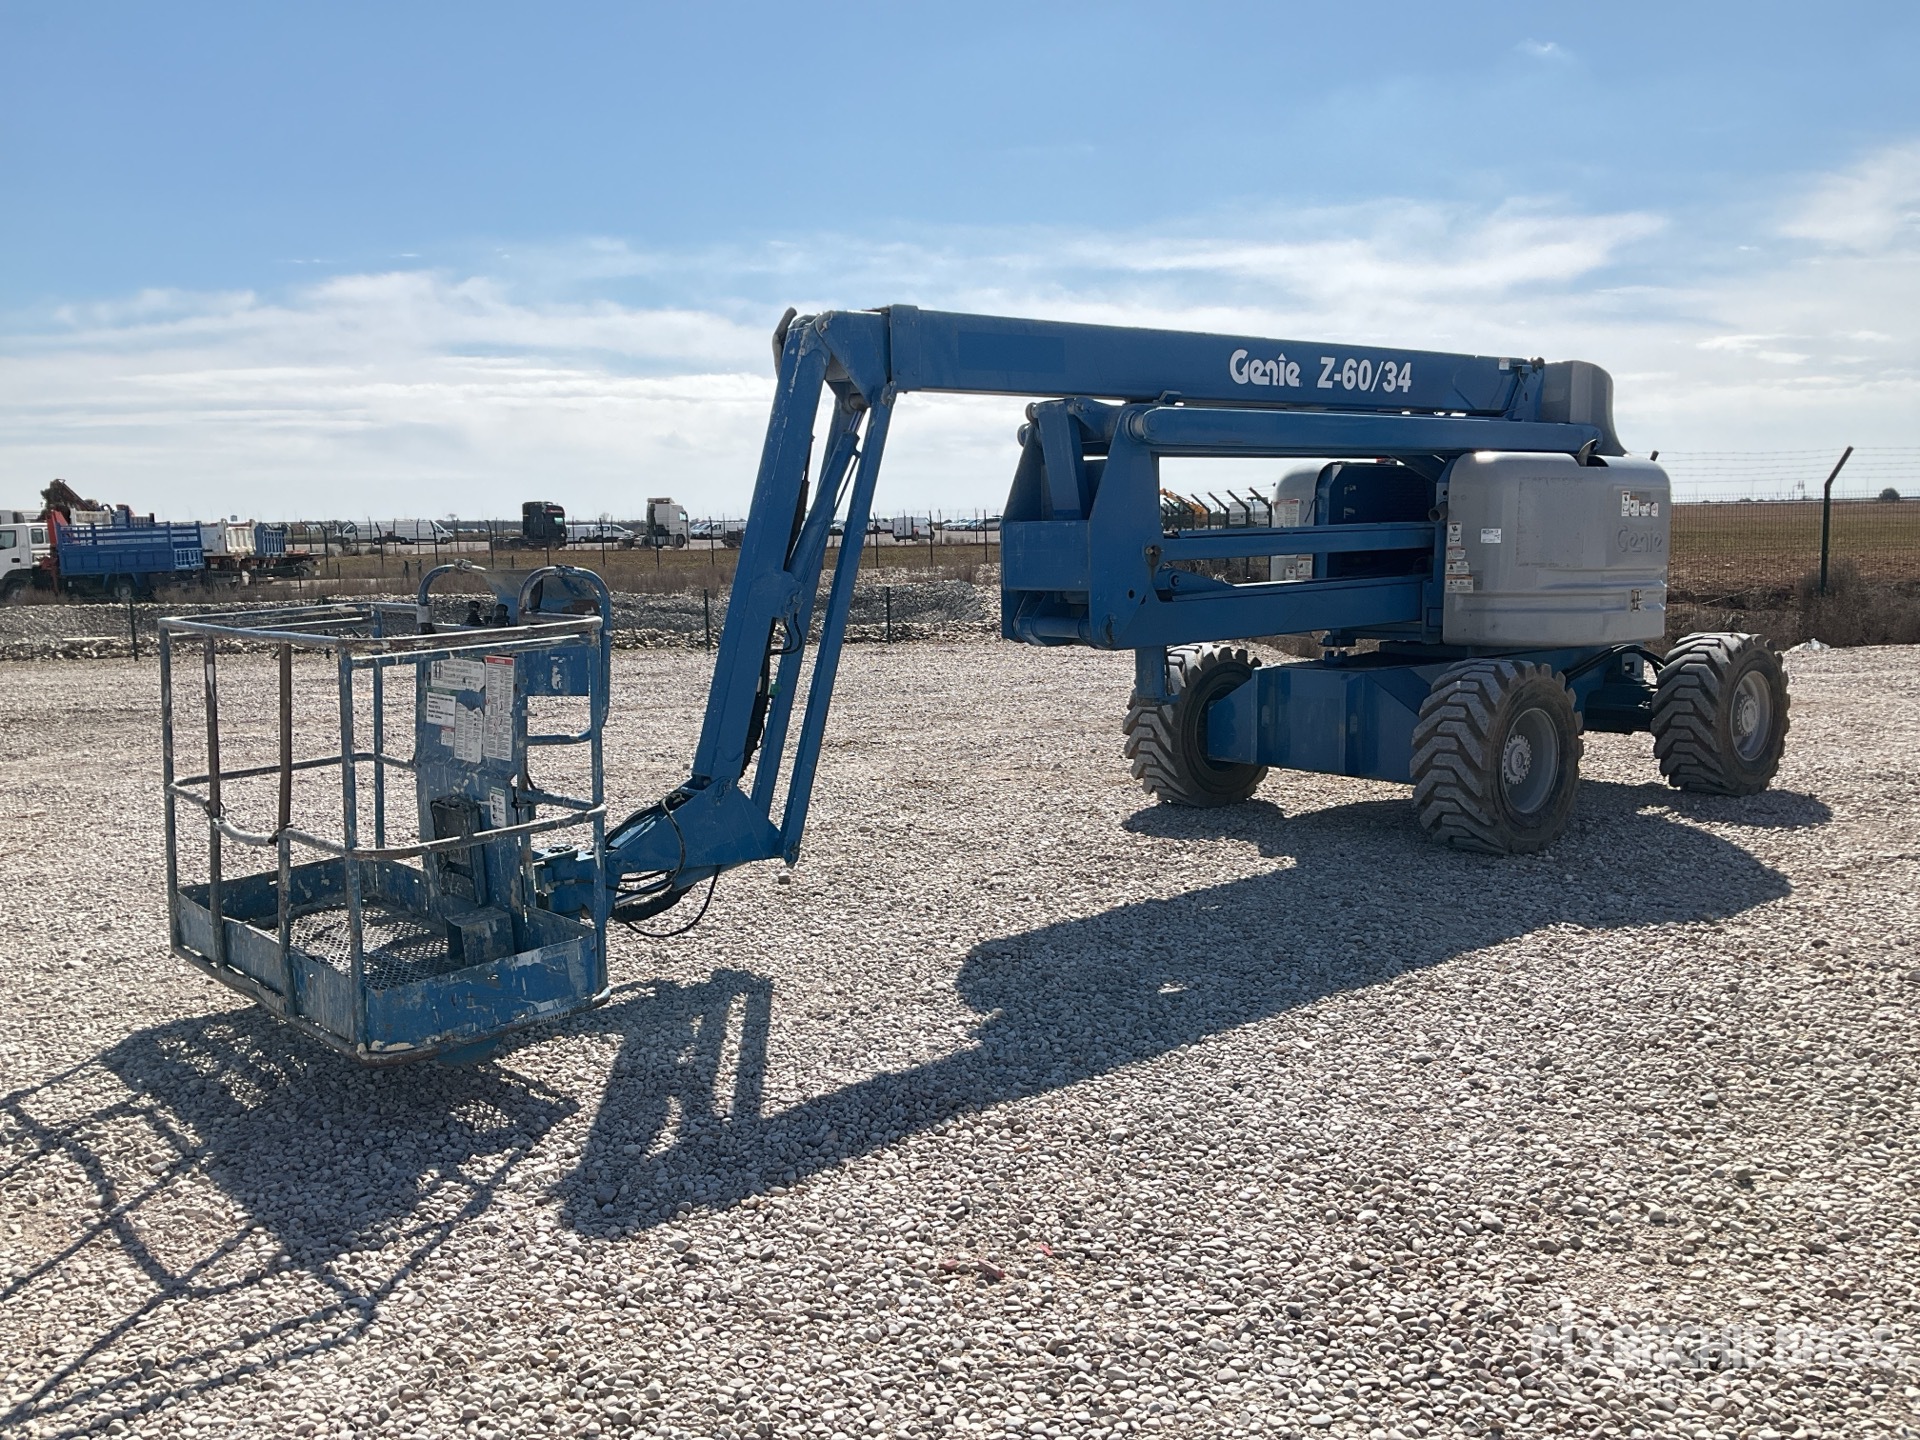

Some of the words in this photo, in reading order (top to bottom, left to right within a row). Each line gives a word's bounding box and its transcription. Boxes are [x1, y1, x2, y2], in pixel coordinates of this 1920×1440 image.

[1229, 349, 1301, 387] Genie
[1317, 356, 1412, 393] Z-60/34
[1616, 525, 1664, 553] Genie
